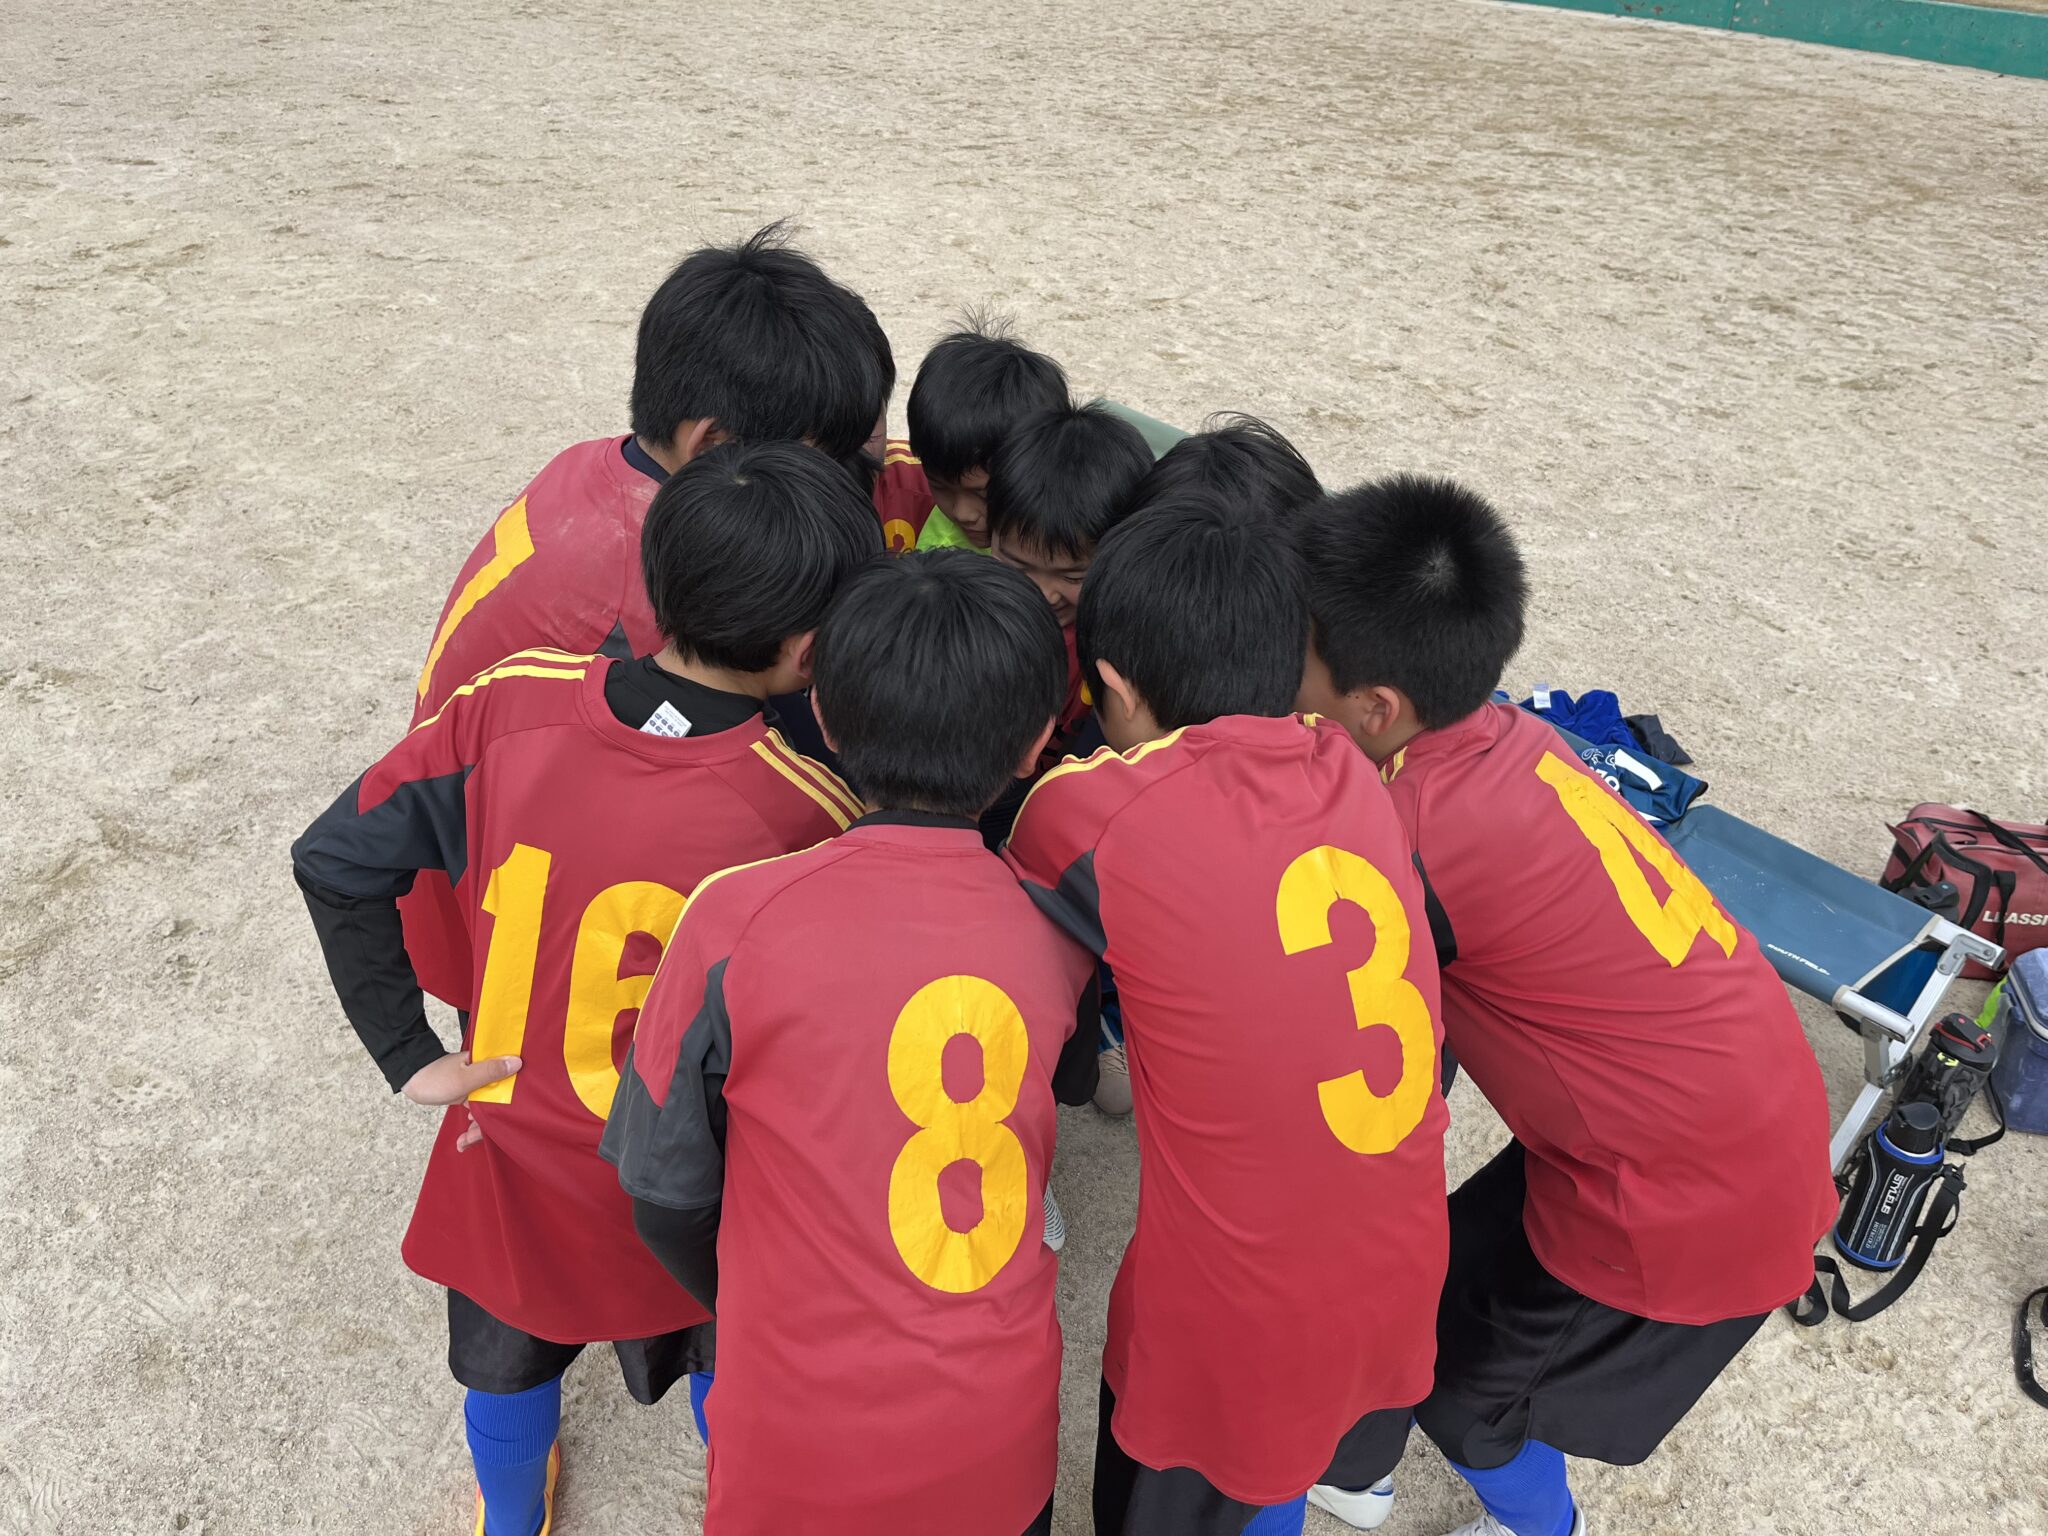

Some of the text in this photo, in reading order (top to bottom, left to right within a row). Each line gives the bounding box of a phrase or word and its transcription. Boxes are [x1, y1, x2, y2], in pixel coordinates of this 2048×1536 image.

[467, 843, 687, 1121] 16
[1276, 845, 1436, 1155] 3
[1535, 751, 1738, 968] 4
[888, 974, 1030, 1294] 8
